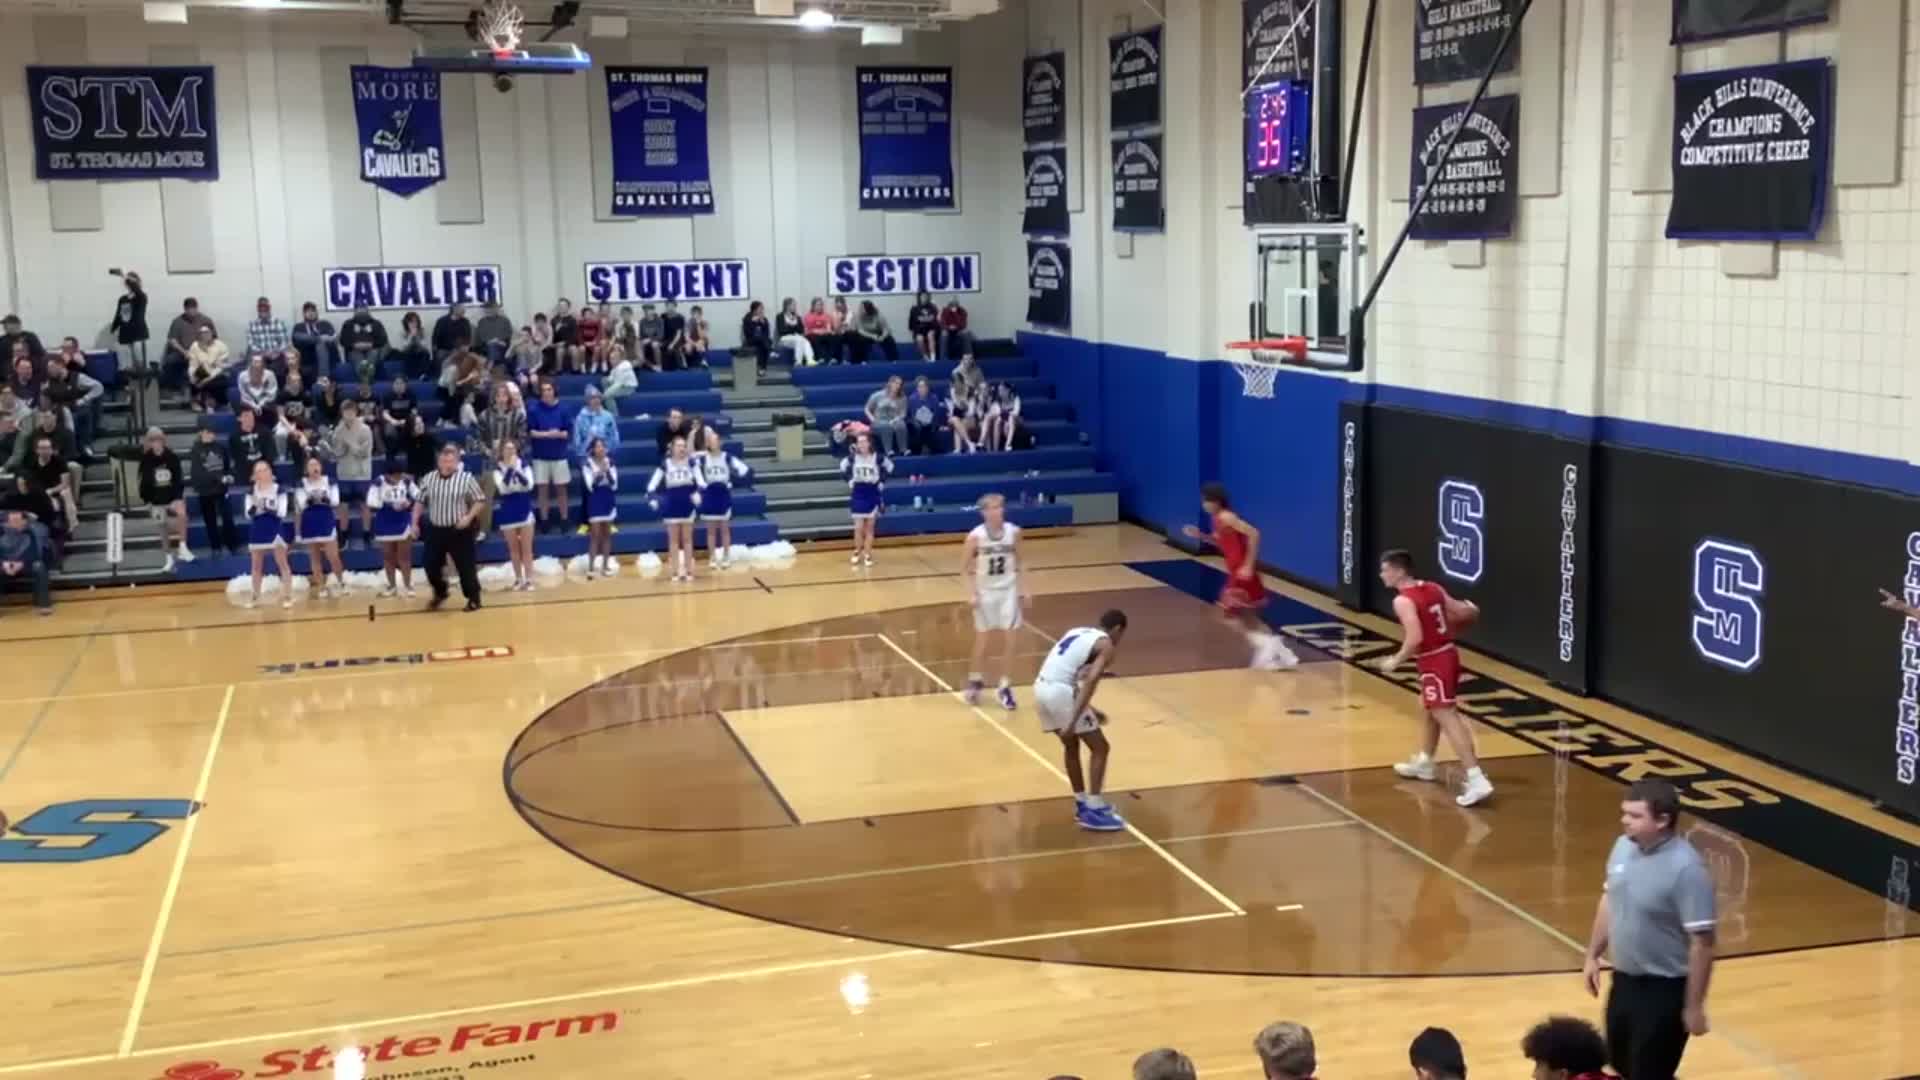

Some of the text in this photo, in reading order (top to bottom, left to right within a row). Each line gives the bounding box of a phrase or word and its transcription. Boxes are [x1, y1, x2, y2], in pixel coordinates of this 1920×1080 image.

[357, 81, 438, 99] MORE
[630, 73, 672, 82] THOMAS
[41, 76, 207, 140] STM
[1680, 77, 1816, 145] BLACK HILLS CONFERENCE
[1709, 113, 1782, 138] CHAMPIONS
[1258, 120, 1280, 167] 35
[1680, 139, 1810, 166] COMPETITIVE CHEER
[78, 151, 151, 168] THOMAS
[154, 151, 205, 168] MORE
[364, 147, 440, 177] CAVALIERS
[616, 194, 711, 205] CAVALIERS
[329, 268, 497, 308] CAVALIER
[590, 263, 743, 301] STUDENT
[835, 256, 973, 294] SECTION
[988, 556, 1006, 576] 12
[1559, 463, 1577, 662] CAVALIERS
[1058, 634, 1081, 656] 4
[450, 1009, 618, 1053] Farm
